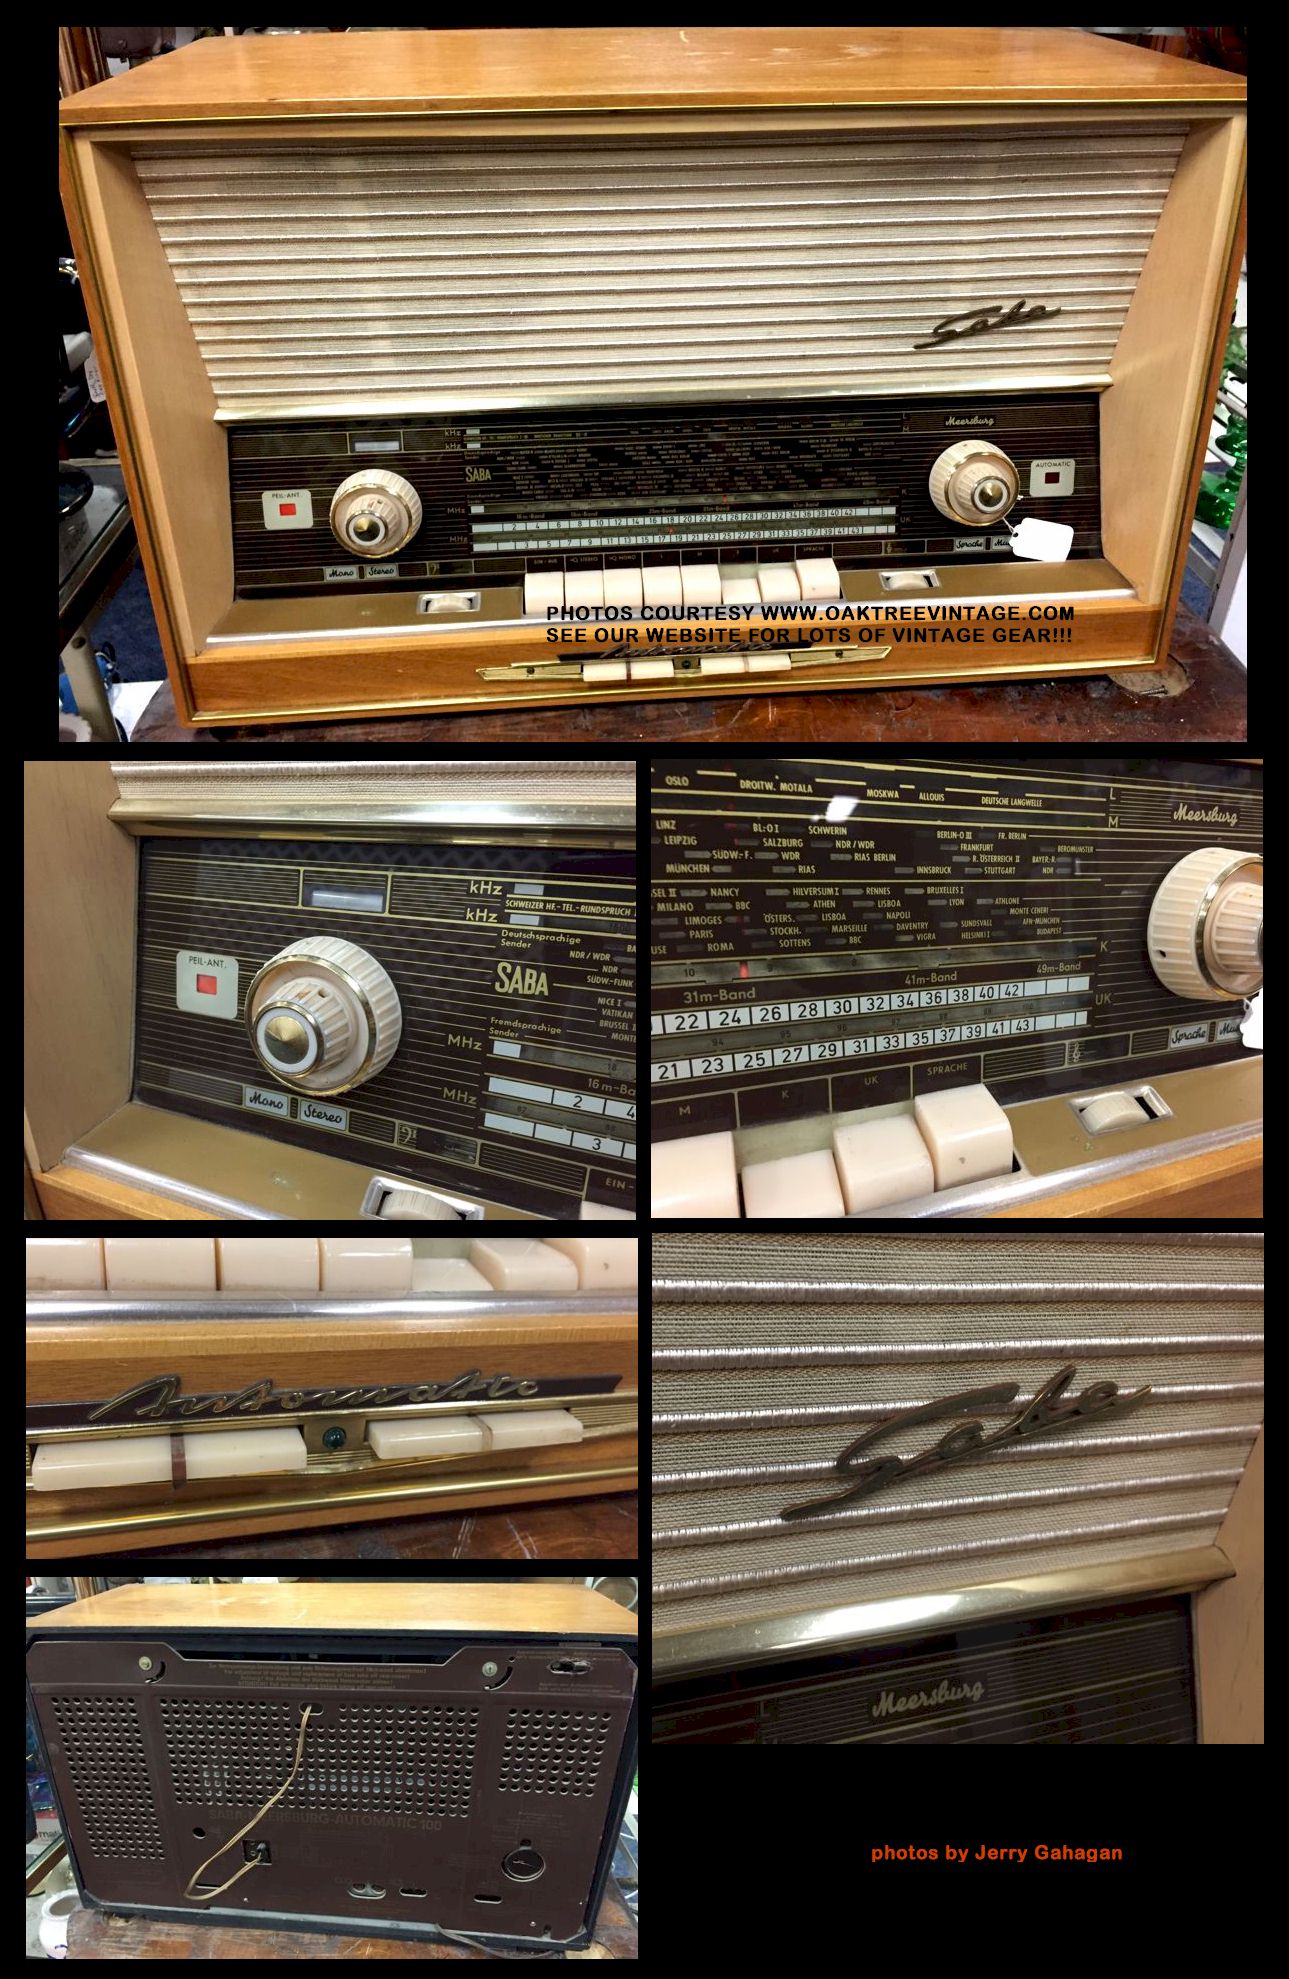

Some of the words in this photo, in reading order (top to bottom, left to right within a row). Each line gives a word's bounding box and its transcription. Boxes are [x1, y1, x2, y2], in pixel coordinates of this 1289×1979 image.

[913, 299, 1062, 350] Saba
[945, 415, 995, 426] Meersburg
[465, 465, 492, 482] SABA
[447, 507, 466, 515] MHz
[329, 566, 355, 578] Mono
[368, 564, 396, 576] Stereo
[665, 776, 689, 786] OSLO
[740, 780, 776, 792] DROITW.
[780, 782, 812, 793] MOTALA
[866, 788, 899, 799] MOSKWA
[919, 792, 945, 801] ALLOUIS
[1109, 787, 1116, 800] L
[981, 796, 1009, 806] DEUTSCHE
[1011, 798, 1042, 808] LANGWELLE
[1173, 802, 1238, 827] Meersburg
[656, 820, 676, 830] LINZ
[1108, 816, 1119, 829] M
[808, 826, 847, 835] SCHWERIN
[664, 836, 697, 846] LEIPZIG
[762, 838, 804, 848] SALZBURG
[835, 840, 851, 849] NDR
[858, 841, 875, 849] WDR
[960, 843, 994, 852] FRANKFURT
[781, 851, 800, 860] WDR
[854, 853, 870, 862] RIAS
[873, 853, 896, 862] BERLIN
[666, 862, 710, 874] MÜNCHEN
[798, 865, 816, 874] RIAS
[917, 866, 951, 874] INNSBRUCK
[470, 880, 502, 895] kHz
[710, 887, 739, 897] NANCY
[792, 887, 833, 896] HILVERSUM
[866, 887, 890, 896] RENNES
[926, 886, 959, 895] BRUXELLES
[505, 899, 544, 910] SCHWEIZER
[656, 902, 694, 912] MILANO
[735, 901, 750, 910] BBC
[813, 900, 836, 908] ATHEN
[877, 899, 901, 908] LISBOA
[949, 898, 965, 906] LYON
[465, 907, 498, 923] kHz
[685, 916, 723, 925] LIMOGES
[821, 913, 847, 921] LISBOA
[831, 924, 868, 933] MARSEILLE
[896, 922, 929, 931] DAVENTRY
[961, 920, 992, 928] SUNDSVALL
[501, 929, 581, 944] Deutschsprachige
[689, 930, 713, 939] PARIS
[770, 927, 801, 936] STOCKH.
[916, 932, 936, 941] VIGRA
[500, 938, 531, 949] Sender
[779, 938, 812, 948] SOTTENS
[849, 936, 862, 944] BBC
[707, 942, 734, 951] ROMA
[1100, 940, 1108, 952] K
[569, 950, 586, 959] NDR
[592, 952, 611, 962] WDR
[188, 955, 227, 969] PEIL-ANT.
[602, 965, 618, 974] NDR
[684, 968, 695, 977] 10
[1037, 962, 1082, 974] 49m-Band
[494, 961, 549, 996] SABA
[905, 972, 958, 985] 41m-Band
[683, 987, 756, 1004] 31m-Band
[1095, 994, 1112, 1006] UK
[598, 997, 615, 1006] NICE
[674, 1013, 699, 1031] 22
[719, 1009, 741, 1026] 24
[760, 1007, 781, 1022] 26
[797, 1003, 818, 1019] 28
[833, 1000, 852, 1014] 30
[866, 996, 885, 1011] 32
[897, 994, 914, 1008] 34
[925, 991, 942, 1005] 36
[953, 989, 969, 1002] 38
[979, 986, 994, 999] 40
[1004, 984, 1019, 997] 42
[602, 1008, 633, 1019] VATIKAN
[490, 1016, 562, 1035] Fremdsprachige
[488, 1026, 519, 1038] Sender
[1171, 1027, 1207, 1045] Sprache
[447, 1033, 482, 1051] MHz
[658, 1064, 678, 1080] 21
[702, 1058, 724, 1074] 23
[744, 1053, 765, 1068] 25
[782, 1048, 803, 1064] 27
[818, 1043, 837, 1058] 29
[853, 1039, 868, 1053] 31
[883, 1035, 900, 1049] 33
[912, 1032, 929, 1045] 35
[940, 1029, 956, 1041] 37
[966, 1025, 982, 1038] 39
[992, 1022, 1004, 1035] 41
[1016, 1020, 1030, 1031] 43
[927, 1062, 968, 1076] SPRACHE
[864, 1076, 879, 1086] UK
[442, 1087, 477, 1106] MHz
[782, 1090, 789, 1099] K
[250, 1091, 284, 1110] Mono
[572, 1095, 583, 1109] 2
[626, 1105, 635, 1119] 4
[679, 1106, 691, 1116] M
[303, 1103, 343, 1124] Stereo
[592, 1138, 602, 1151] 3
[605, 1177, 626, 1190] EIN
[88, 1369, 540, 1423] Automatic
[780, 1363, 1152, 1521] Saba
[872, 1679, 985, 1719] Meersburg
